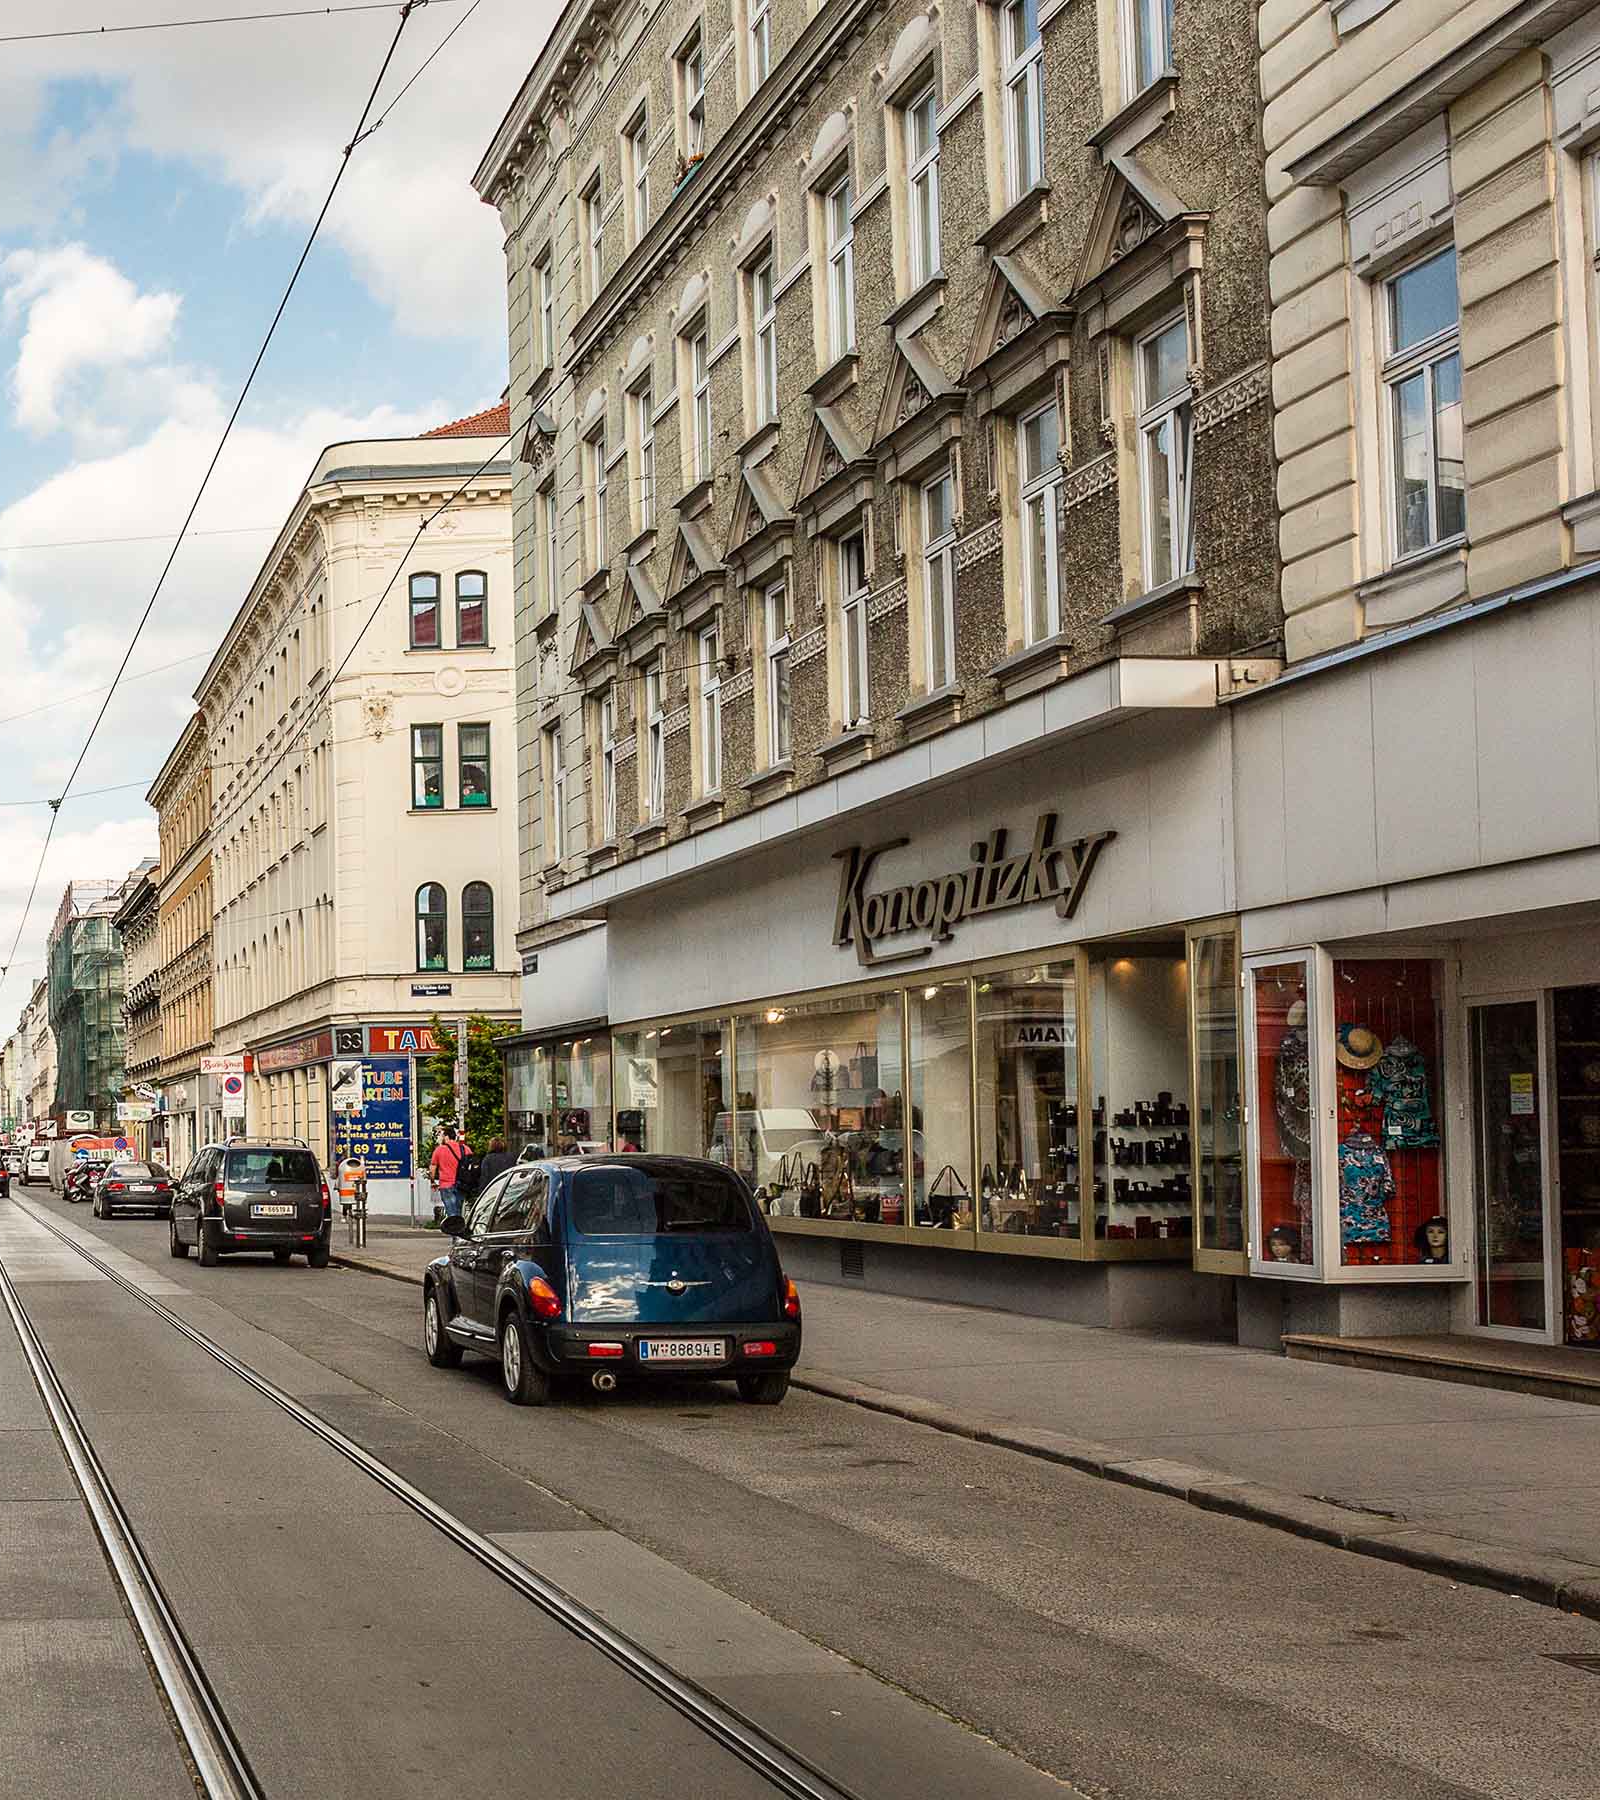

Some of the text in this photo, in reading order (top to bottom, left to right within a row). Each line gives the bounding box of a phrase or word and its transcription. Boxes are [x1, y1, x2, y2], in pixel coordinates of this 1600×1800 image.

[832, 813, 1118, 967] Konopitzky
[337, 1032, 362, 1050] 133
[362, 1071, 403, 1085] TUBE
[365, 1122, 386, 1130] 6-20
[388, 1122, 404, 1130] Uhr
[353, 1143, 370, 1154] 69
[374, 1143, 388, 1154] 71
[649, 1343, 660, 1357] W
[713, 1343, 721, 1357] E
